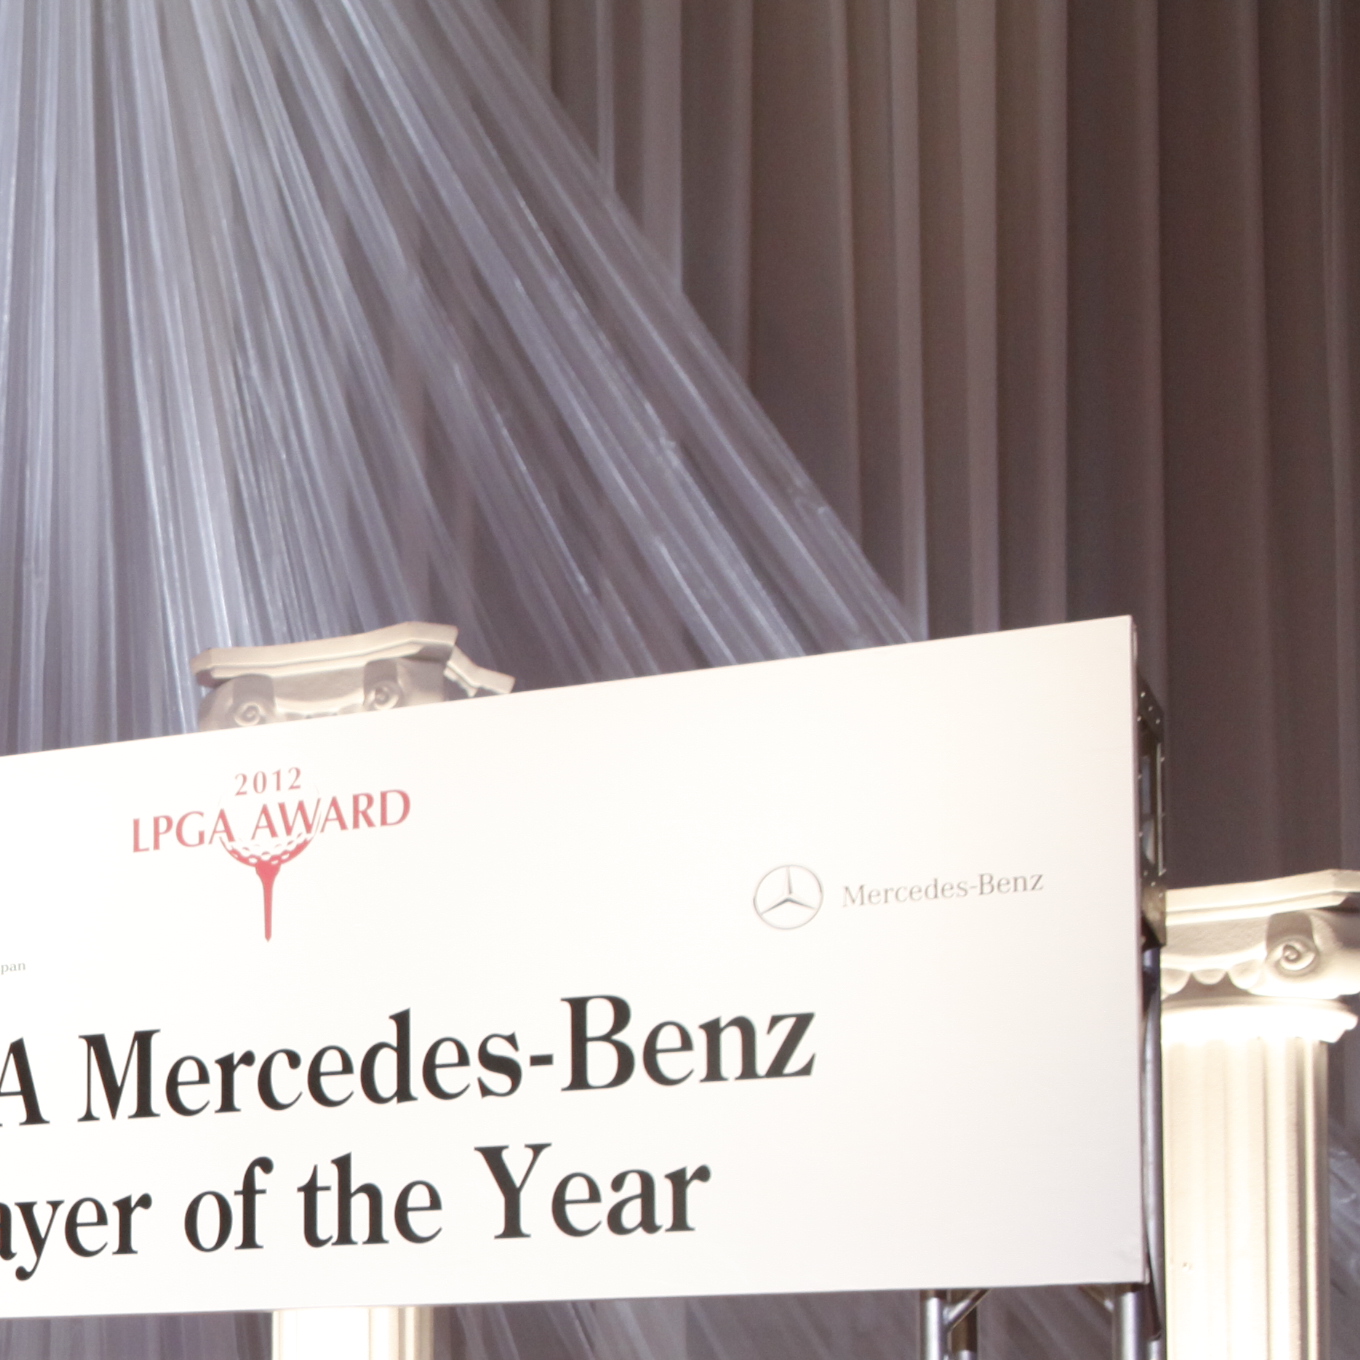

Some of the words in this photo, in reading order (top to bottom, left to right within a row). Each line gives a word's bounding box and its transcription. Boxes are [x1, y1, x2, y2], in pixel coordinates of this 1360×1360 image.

[234, 766, 303, 797] 2012
[131, 808, 238, 854] LPGA
[250, 789, 412, 841] AWARD
[841, 872, 1046, 910] Mercedes-Benz
[77, 994, 816, 1123] Mercedes-Benz
[183, 1156, 275, 1253] of
[296, 1151, 443, 1249] the
[473, 1142, 712, 1240] Year
